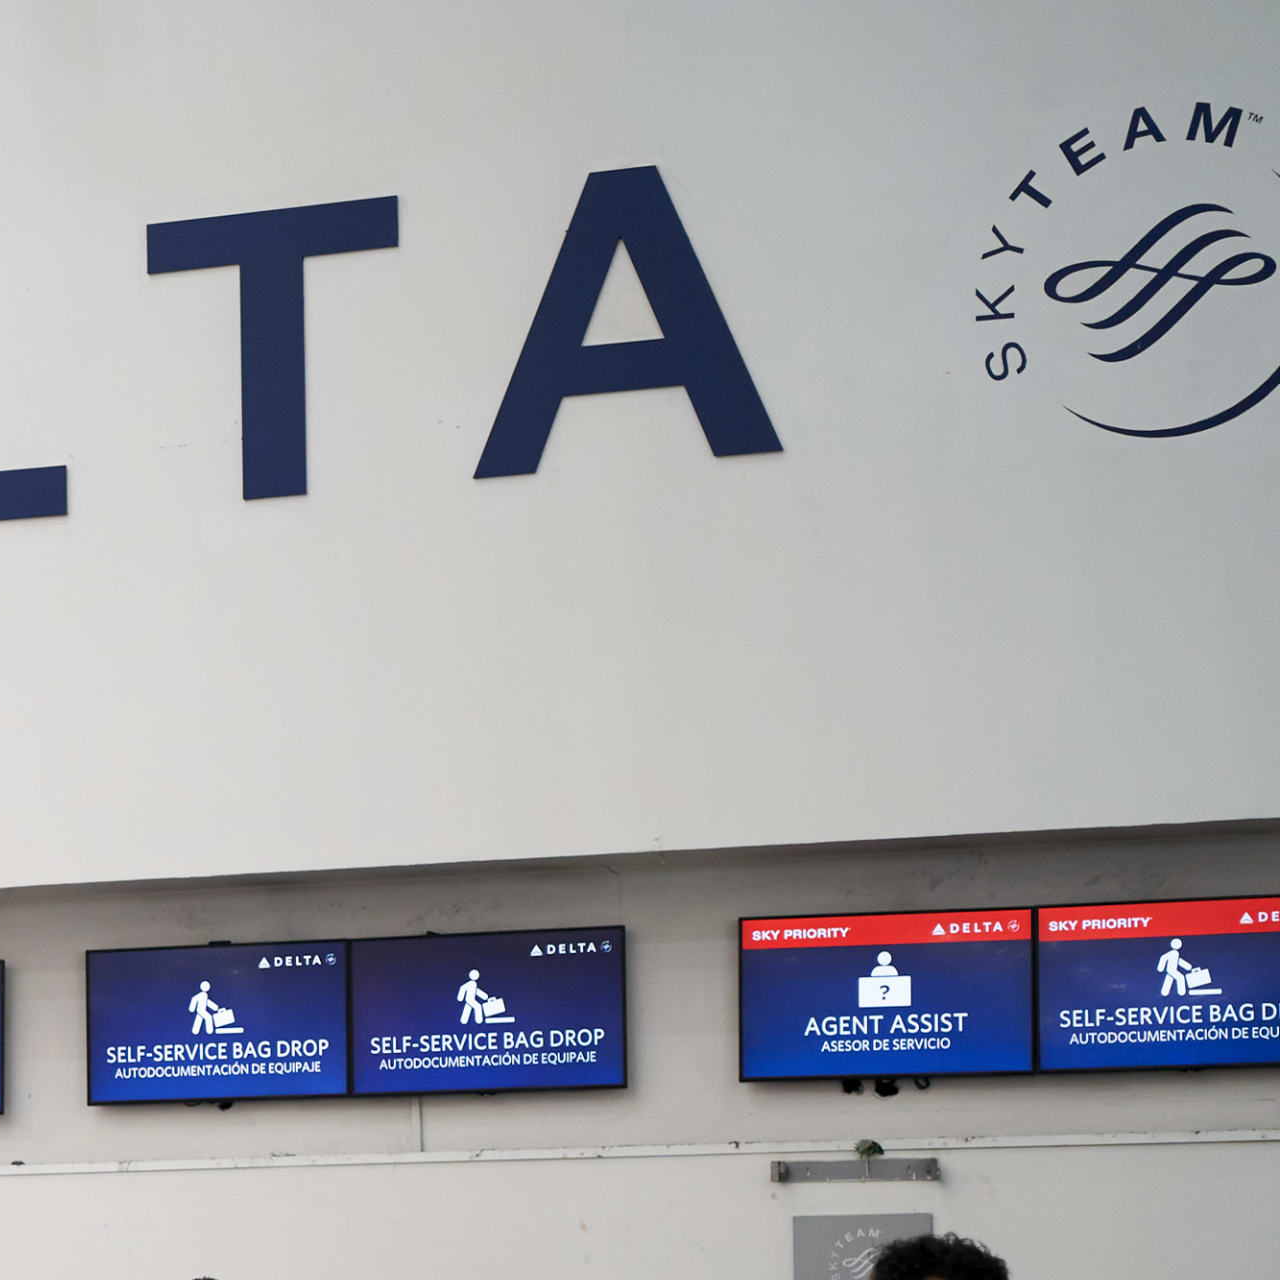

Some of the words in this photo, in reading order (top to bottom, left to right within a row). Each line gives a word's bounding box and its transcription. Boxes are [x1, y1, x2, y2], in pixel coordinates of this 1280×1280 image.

[975, 101, 1244, 382] SKYTEAM
[752, 929, 780, 941] SKY
[784, 926, 849, 940] PRIORITY
[950, 921, 1004, 934] DELTA
[1049, 920, 1081, 932] SKY
[1083, 916, 1151, 930] PRIORITY
[546, 942, 597, 955] DELTA
[273, 954, 322, 968] DELTA
[804, 1015, 883, 1036] AGENT
[889, 1012, 969, 1034] ASSIST
[1059, 1006, 1203, 1028] SELF-SERVICE
[1209, 1004, 1255, 1023] BAG
[370, 1032, 498, 1055] SELF-SERVICE
[503, 1031, 543, 1051] BAG
[549, 1029, 605, 1049] DROP
[821, 1038, 870, 1053] ASESOR
[872, 1038, 890, 1051] DE
[892, 1036, 951, 1051] SERVICIO
[1069, 1025, 1228, 1045] AUTODOCUMENTACIÓN
[1232, 1027, 1249, 1039] DE
[107, 1041, 228, 1063] SELF-SERVICE
[232, 1041, 272, 1061] BAG
[276, 1039, 329, 1059] DROP
[115, 1060, 249, 1078] AUTODOCUMENTACIÓN
[251, 1064, 266, 1075] DE
[268, 1061, 322, 1075] EQUIPAJE
[379, 1051, 522, 1071] AUTODOCUMENTACIÓN
[524, 1055, 539, 1067] DE
[541, 1051, 597, 1067] EQUIPAJE
